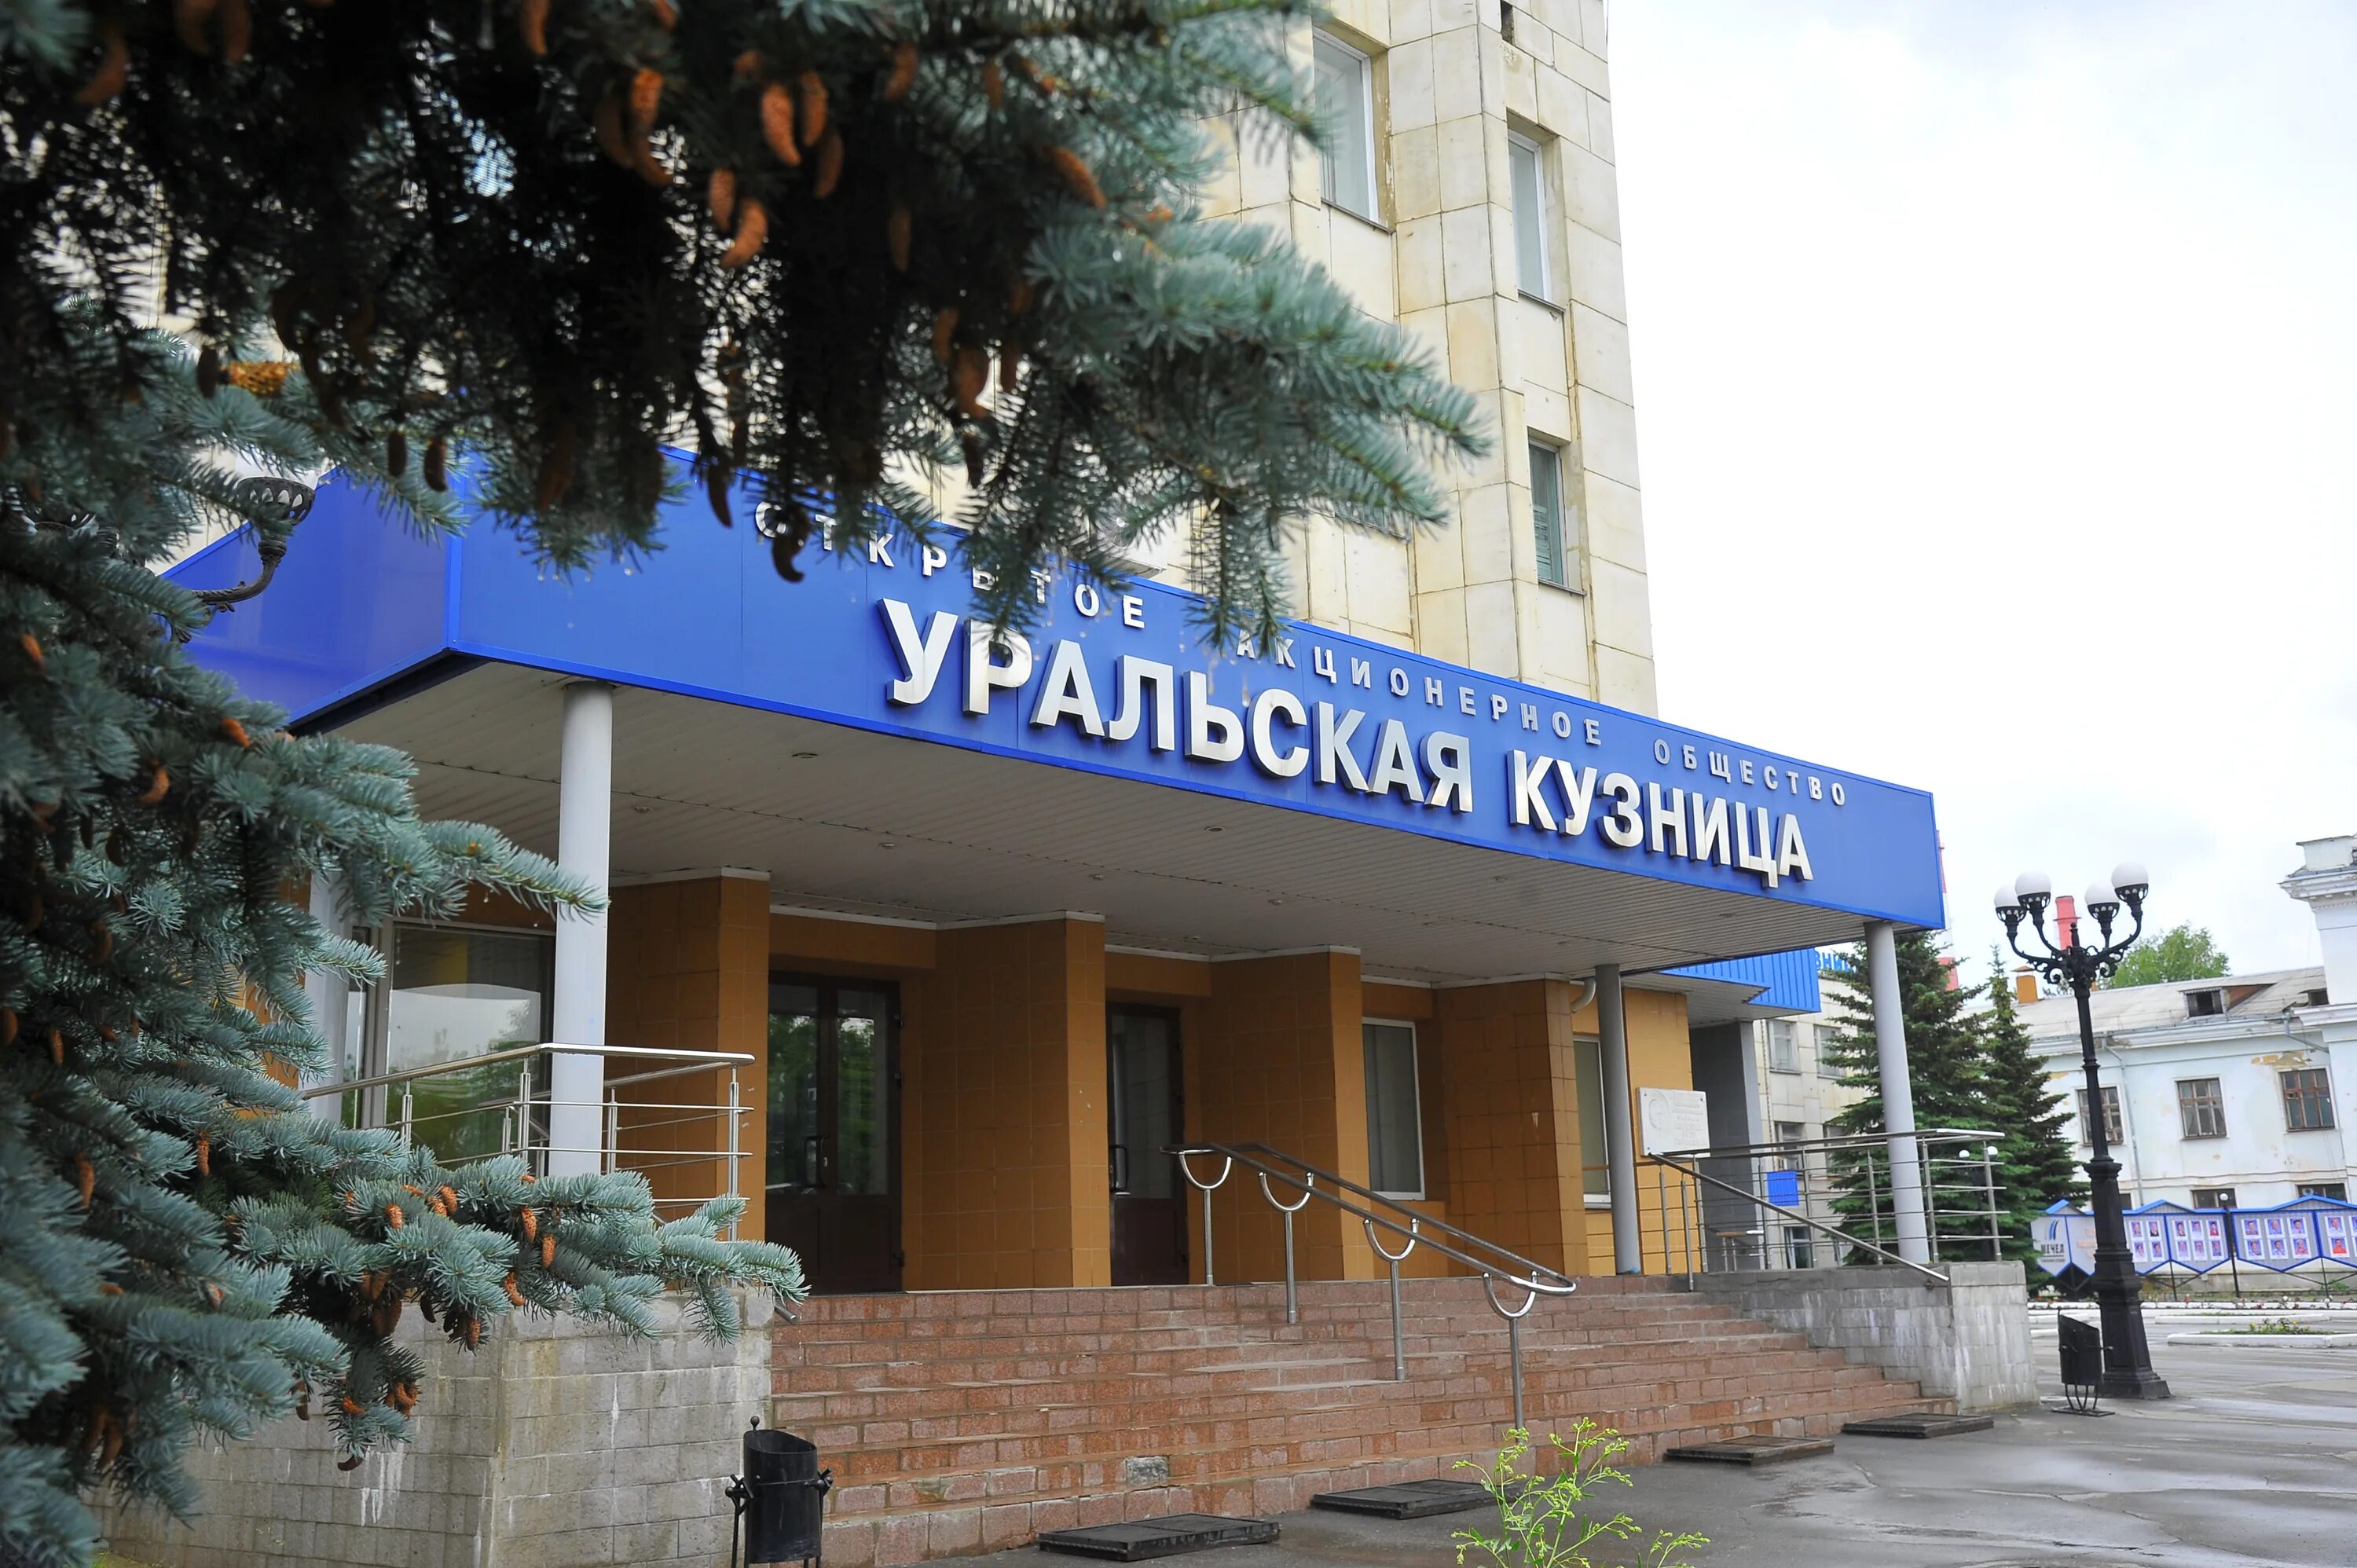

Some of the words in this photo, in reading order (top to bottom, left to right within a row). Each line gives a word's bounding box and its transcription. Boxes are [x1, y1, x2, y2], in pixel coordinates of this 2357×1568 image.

[878, 598, 1473, 814] УРАЛЬСКАЯ
[1507, 749, 1814, 889] КУЗНИЦА
[1237, 628, 1601, 746] АКЦИОНЕРНОЕ
[1654, 738, 1846, 807] ОБЩЕСТВО
